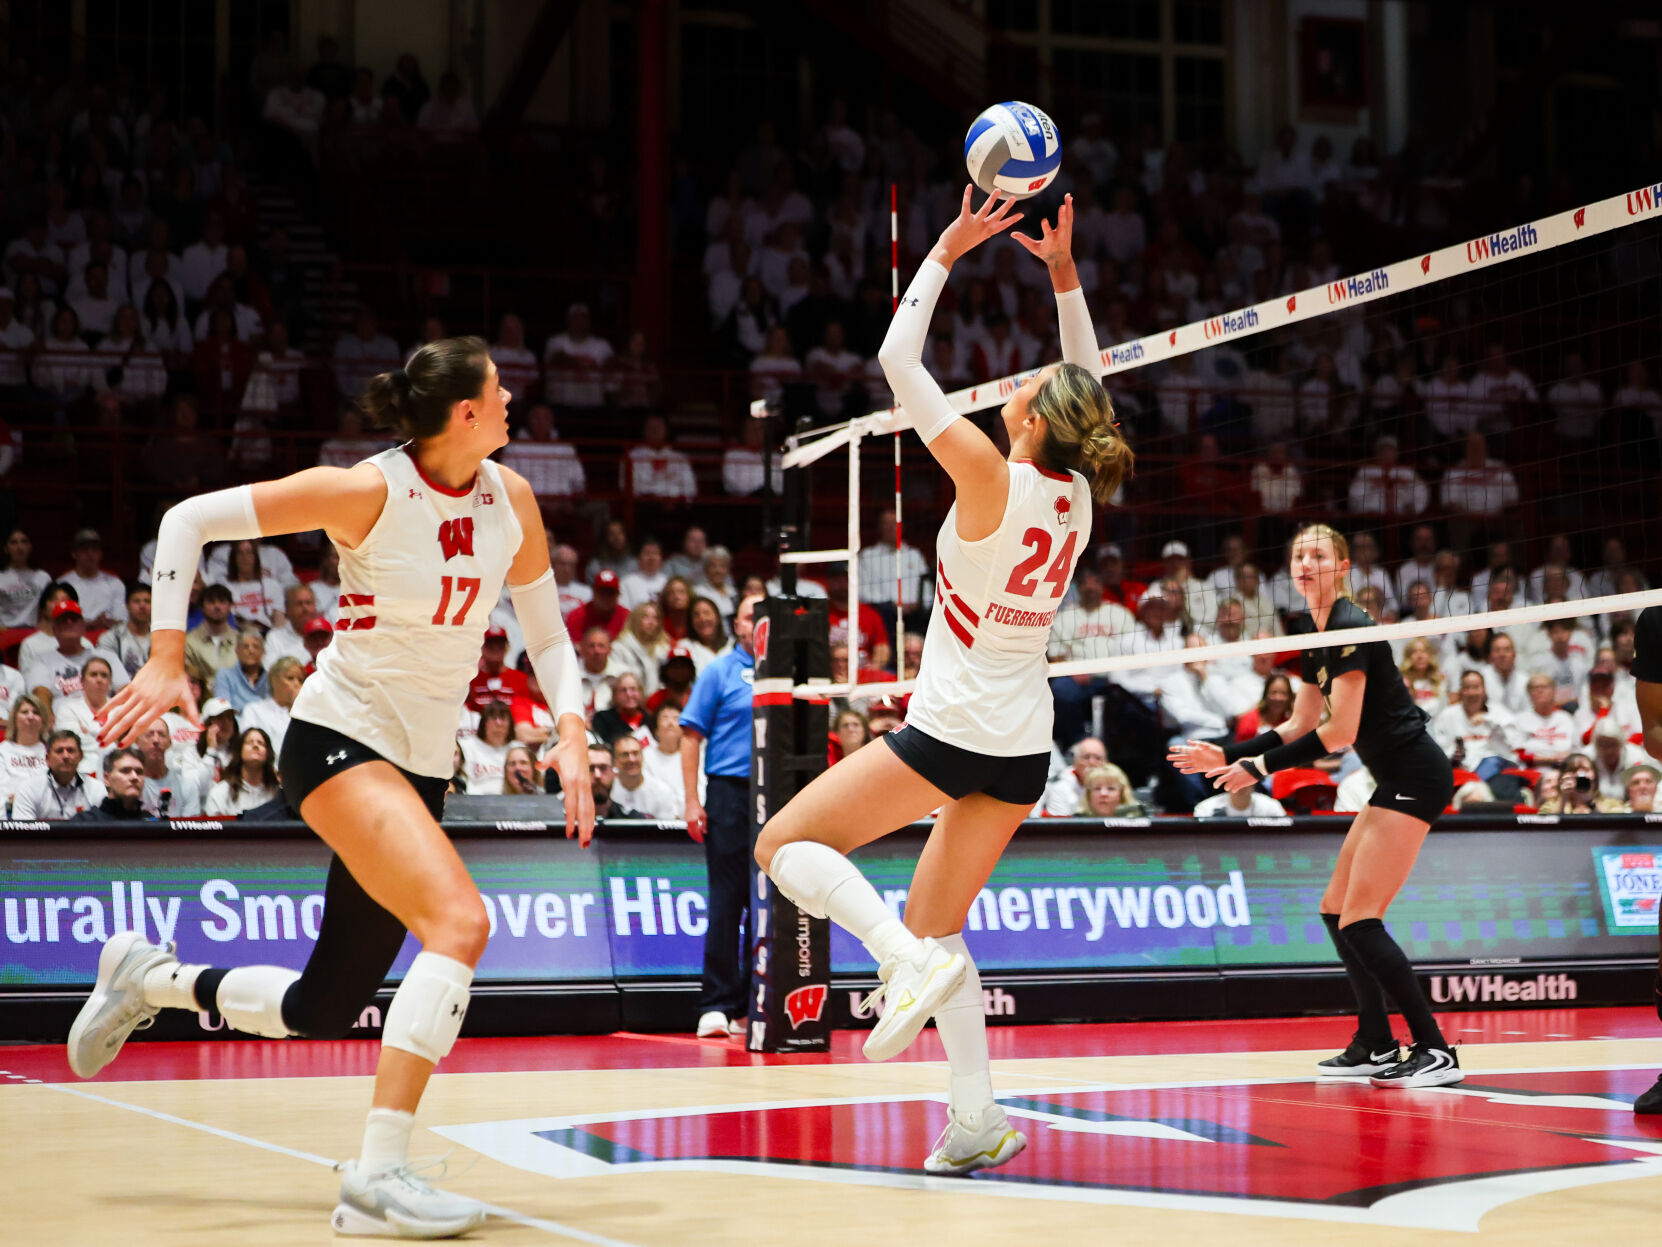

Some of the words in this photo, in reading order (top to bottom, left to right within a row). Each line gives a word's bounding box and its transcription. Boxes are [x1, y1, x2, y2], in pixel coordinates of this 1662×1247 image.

[1466, 223, 1538, 265] UWHealth
[1328, 268, 1389, 304] UWHealth
[1204, 308, 1259, 340] UWHealth
[1100, 342, 1145, 368] WHealth
[1004, 526, 1078, 599] 24
[432, 575, 481, 626] 17
[1614, 873, 1662, 892] JONE
[4, 880, 182, 951] urally
[199, 878, 326, 942] Smo
[609, 876, 709, 938] Hic
[1430, 972, 1578, 1004] UWHealth
